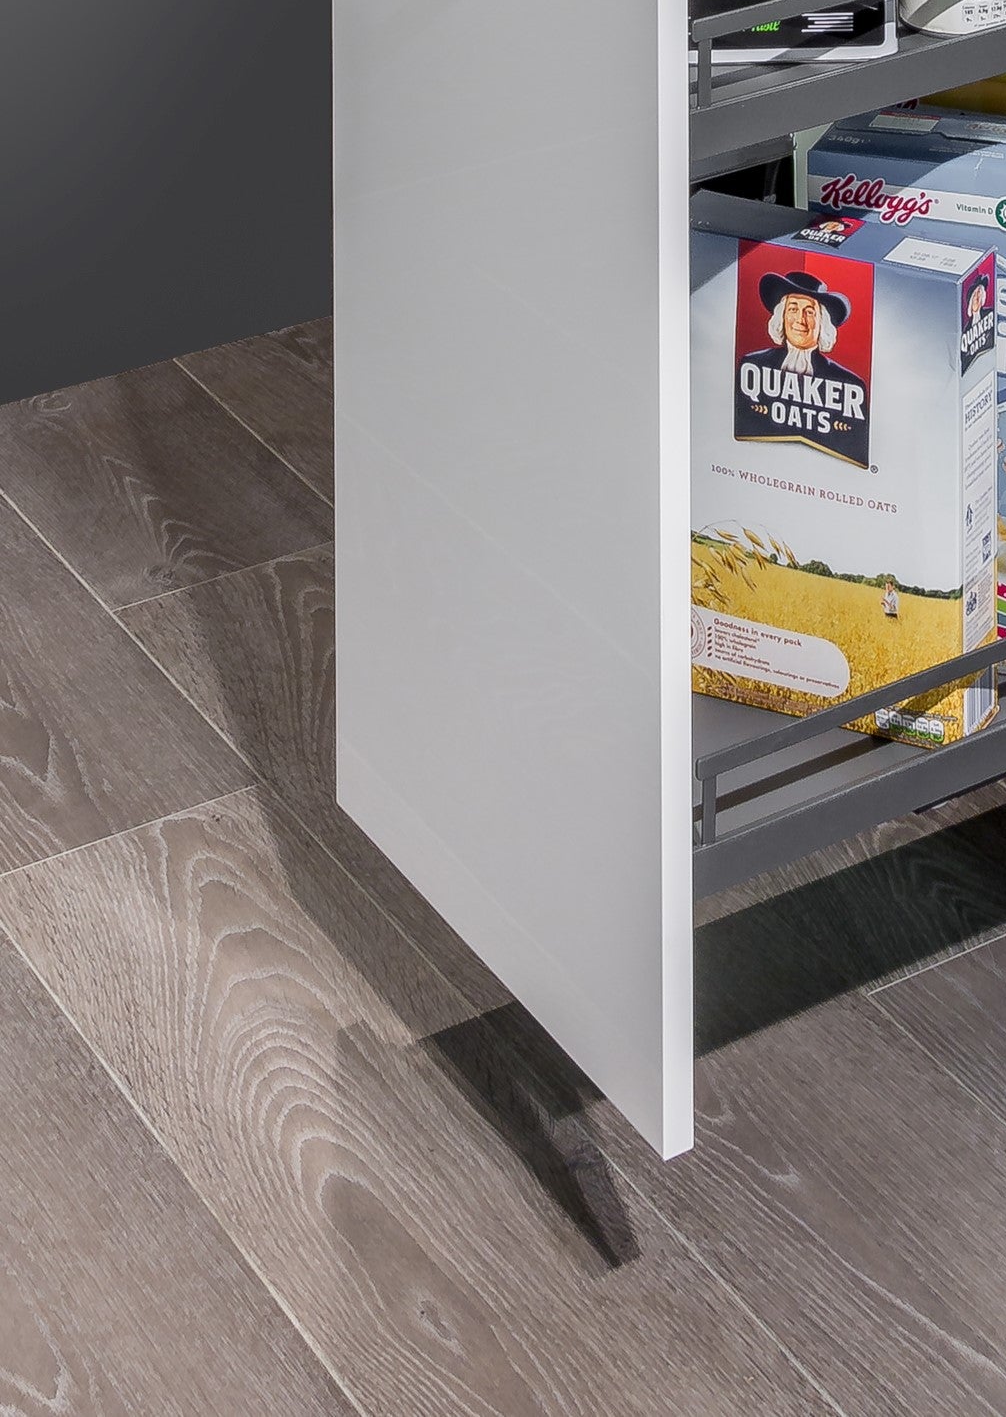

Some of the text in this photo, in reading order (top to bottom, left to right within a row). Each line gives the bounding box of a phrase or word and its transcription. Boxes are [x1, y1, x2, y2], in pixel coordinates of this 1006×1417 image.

[820, 175, 934, 225] Kellogg's
[956, 203, 993, 215] Vitamin D
[800, 228, 845, 243] QUAKER
[961, 312, 994, 352] QUAKER
[969, 336, 987, 356] OATS
[739, 362, 866, 420] QUAKER
[771, 401, 831, 434] OATS
[965, 389, 993, 425] HISTORY
[711, 464, 898, 513] 100% WHOLEGRAIN ROLLED OATS
[713, 618, 802, 647] Goodness in every pack
[715, 640, 725, 649] high
[722, 655, 742, 665] artificial
